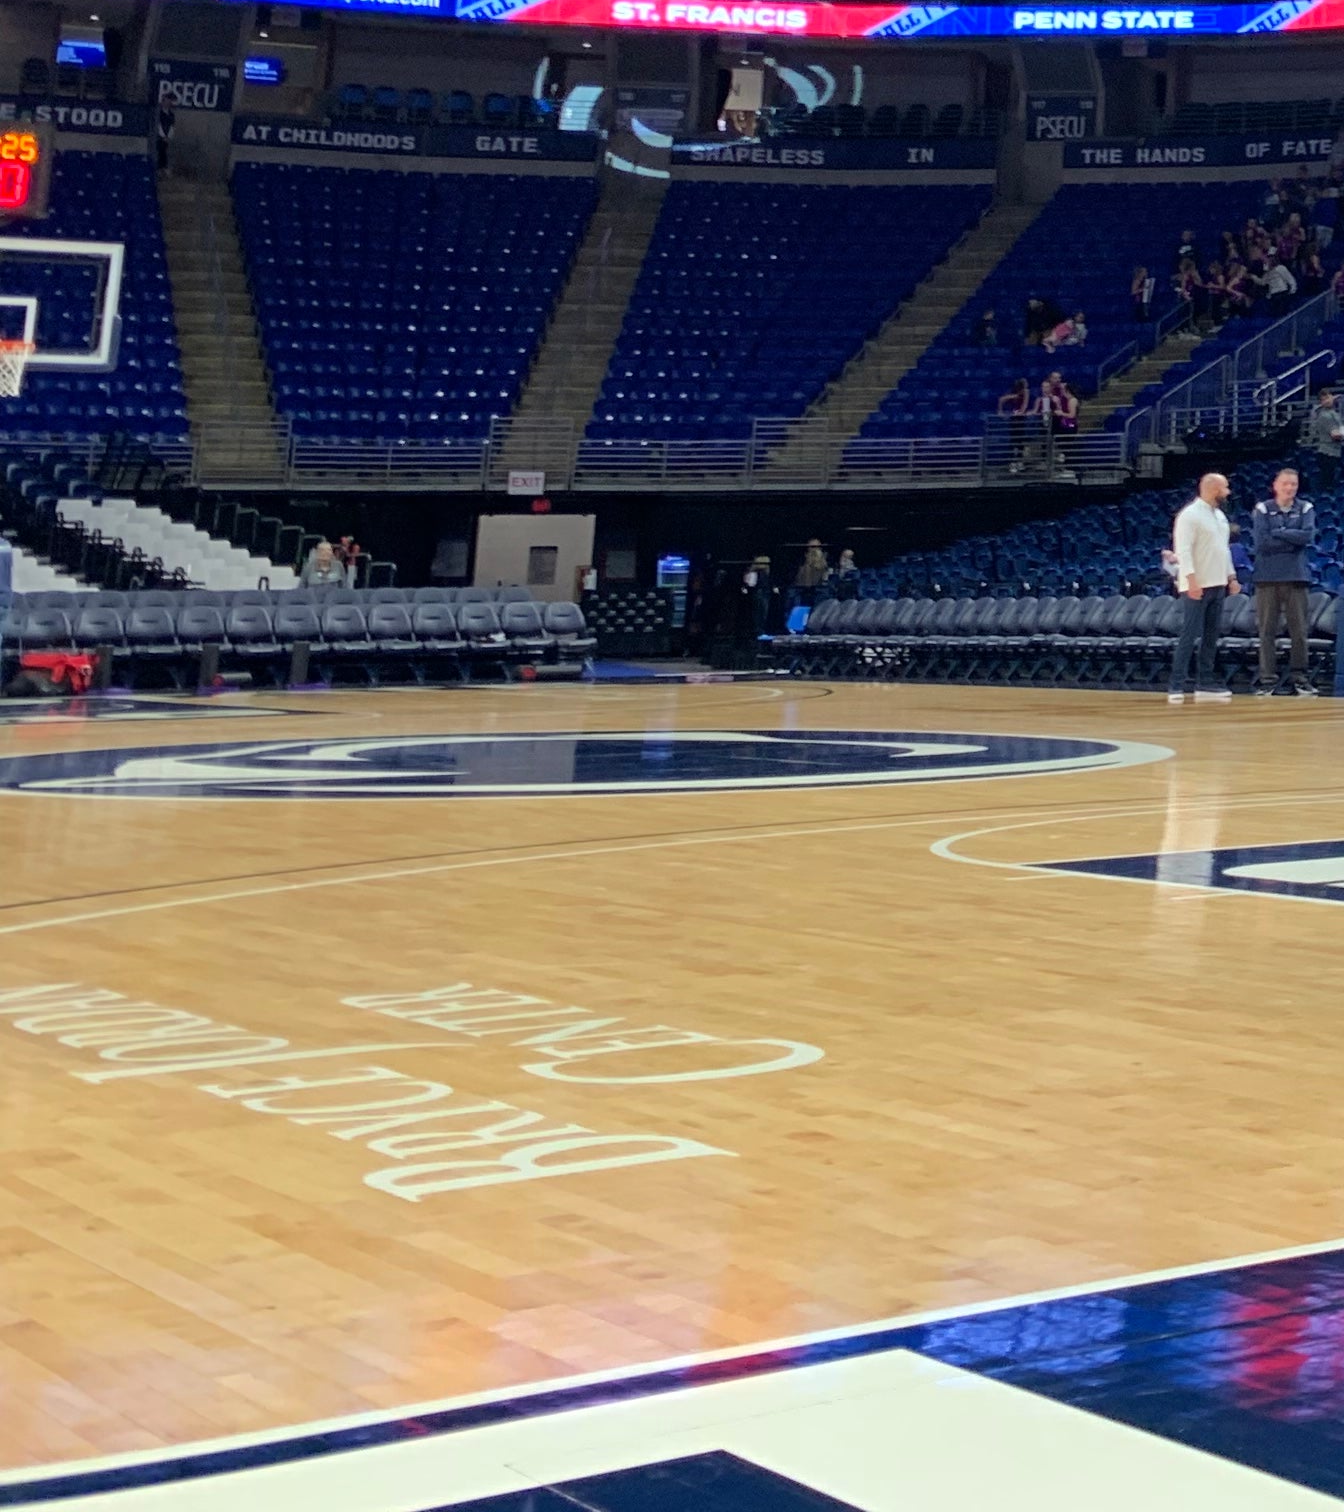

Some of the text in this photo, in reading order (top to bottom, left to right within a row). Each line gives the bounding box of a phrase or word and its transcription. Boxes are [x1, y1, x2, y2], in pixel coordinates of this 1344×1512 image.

[612, 0, 807, 29] ST. FRANCIS
[1014, 10, 1195, 30] PENN STATE
[159, 80, 219, 108] PSECU
[35, 105, 123, 128] STOOD
[1036, 115, 1086, 139] PSECU
[242, 124, 270, 141] AT
[907, 146, 935, 164] IN
[1081, 138, 1333, 165] THE HANDS OF FATE
[511, 476, 542, 488] EXIT
[341, 982, 825, 1085] CENTER
[199, 1066, 740, 1203] BRYCE
